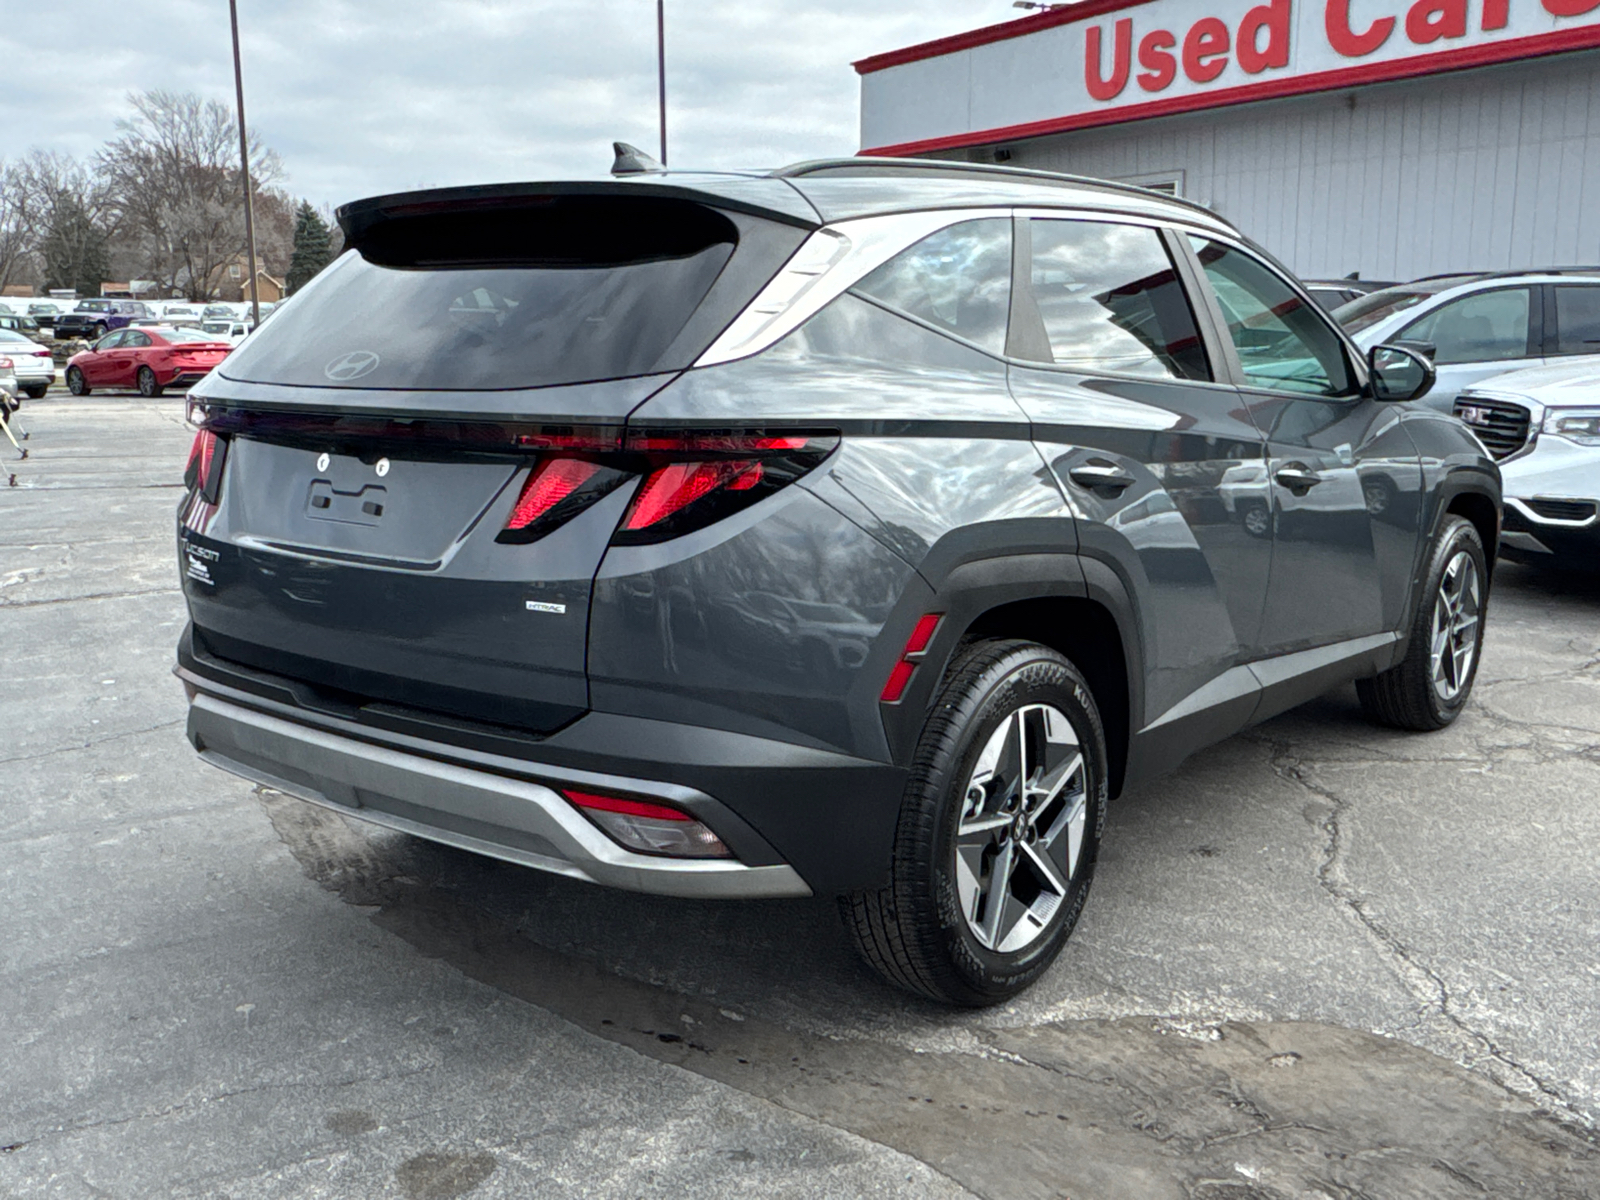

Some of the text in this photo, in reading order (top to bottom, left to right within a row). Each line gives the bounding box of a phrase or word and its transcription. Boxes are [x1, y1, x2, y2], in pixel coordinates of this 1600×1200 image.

[1085, 0, 1600, 101] Used Ca
[528, 603, 563, 613] HTRAC
